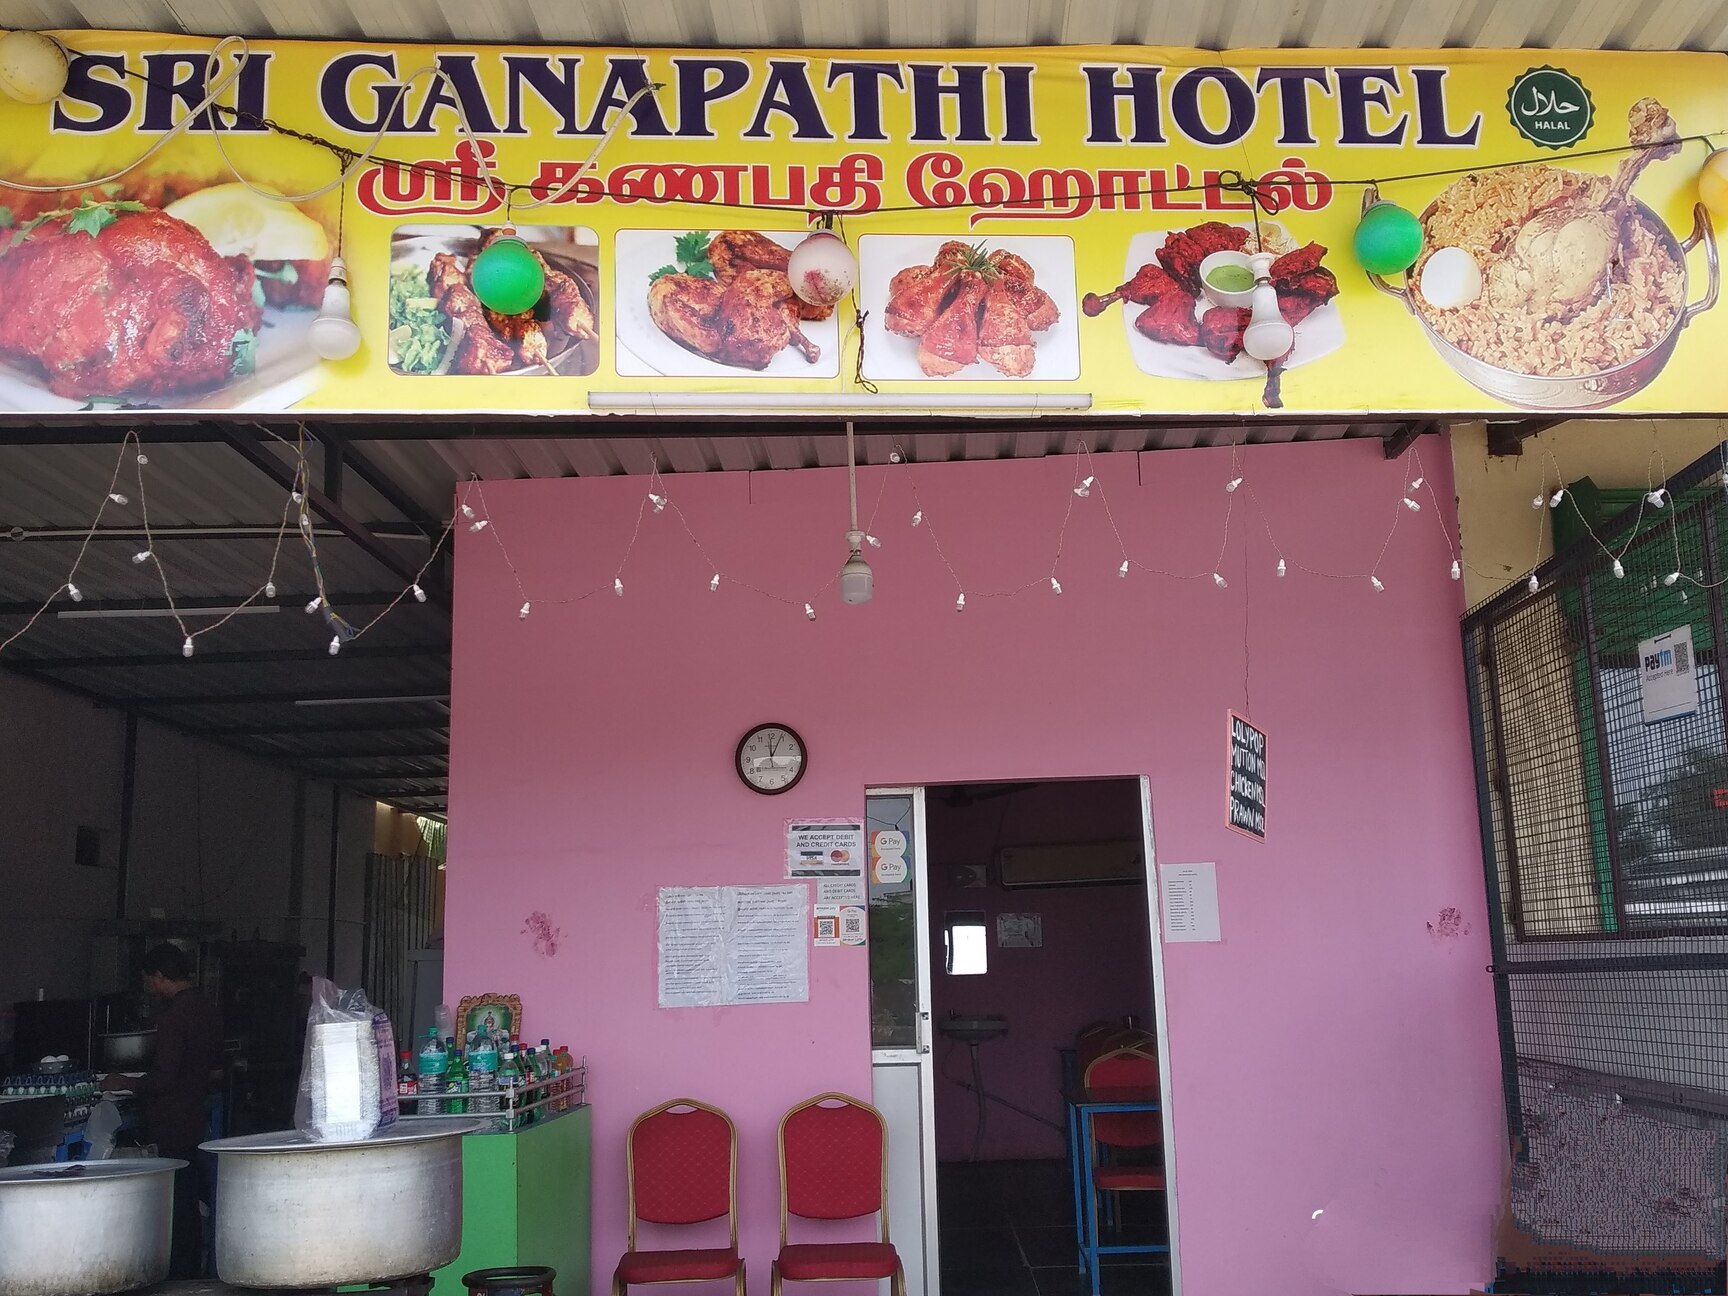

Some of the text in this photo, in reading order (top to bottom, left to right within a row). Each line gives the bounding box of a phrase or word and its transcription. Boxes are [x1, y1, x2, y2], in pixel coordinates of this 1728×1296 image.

[51, 51, 1481, 147] SRI GANAPATHI HOTEL
[1521, 85, 1580, 116] حلال
[1535, 120, 1571, 130] HALAL
[530, 152, 885, 226] கணபதி
[906, 151, 1334, 230] ஹோட்டல்
[1231, 717, 1264, 756] LOLYPOP
[1231, 744, 1256, 774] MUTTON
[1230, 770, 1256, 801] CHICKEN
[1229, 796, 1255, 828] PRAWN
[889, 837, 901, 846] Pay
[889, 863, 901, 871] Pay
